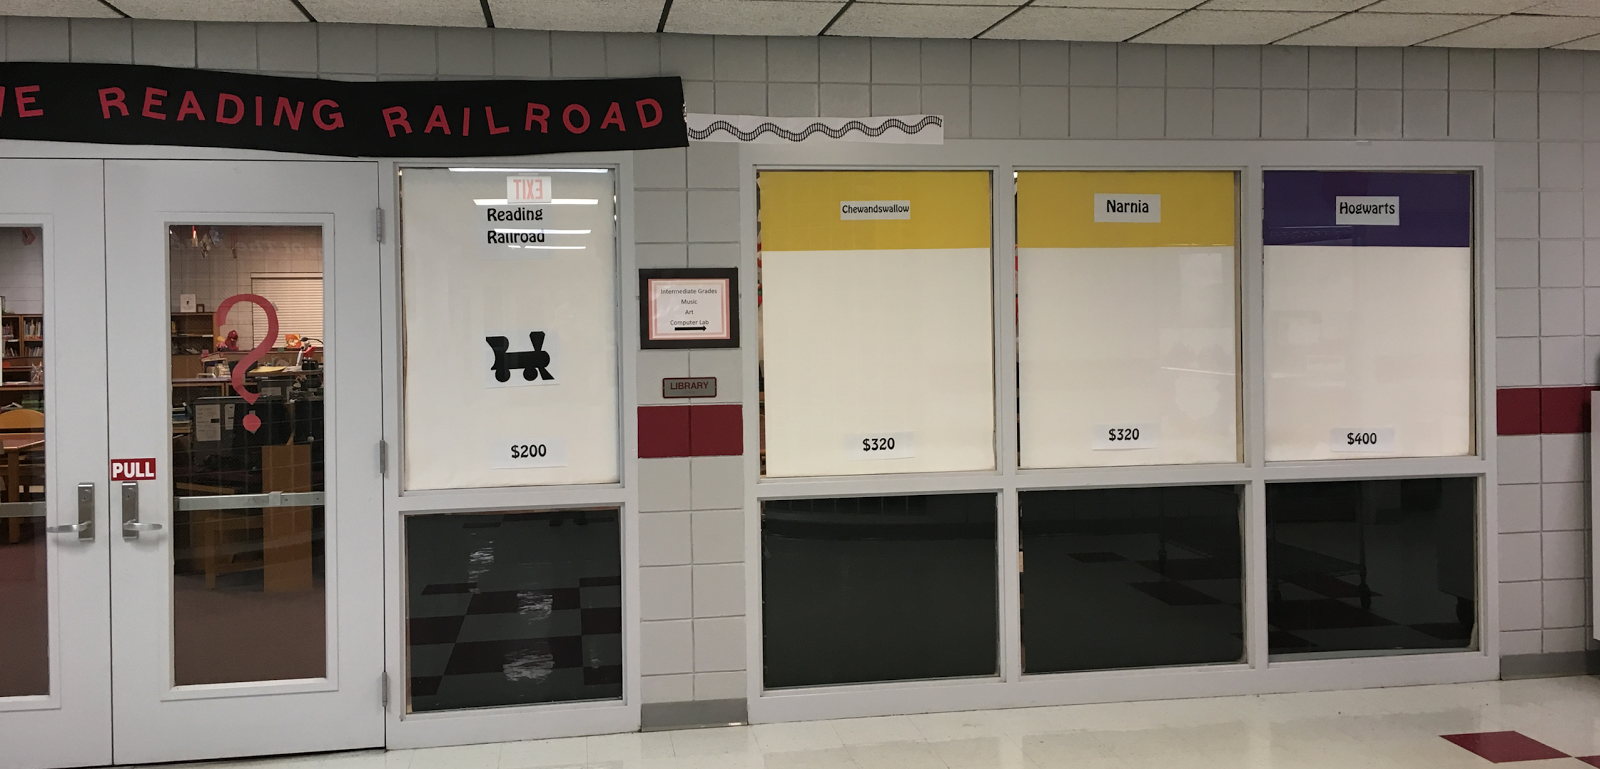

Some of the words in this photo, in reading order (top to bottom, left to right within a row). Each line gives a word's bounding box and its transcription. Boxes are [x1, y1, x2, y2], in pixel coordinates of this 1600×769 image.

[0, 84, 44, 118] E
[98, 86, 345, 132] READING
[381, 97, 664, 138] RAILROAD
[841, 204, 910, 214] Chewandswallow
[1106, 199, 1149, 213] Narnia
[1339, 201, 1396, 215] Hogwarts
[487, 207, 544, 222] Reading
[487, 229, 545, 244] Railroad
[669, 319, 698, 327] Computer
[670, 381, 709, 390] LIBRARY
[1108, 428, 1140, 442] $320
[1346, 432, 1378, 446] $400
[510, 443, 547, 459] $200
[862, 436, 896, 452] $320
[112, 461, 155, 479] PULL
